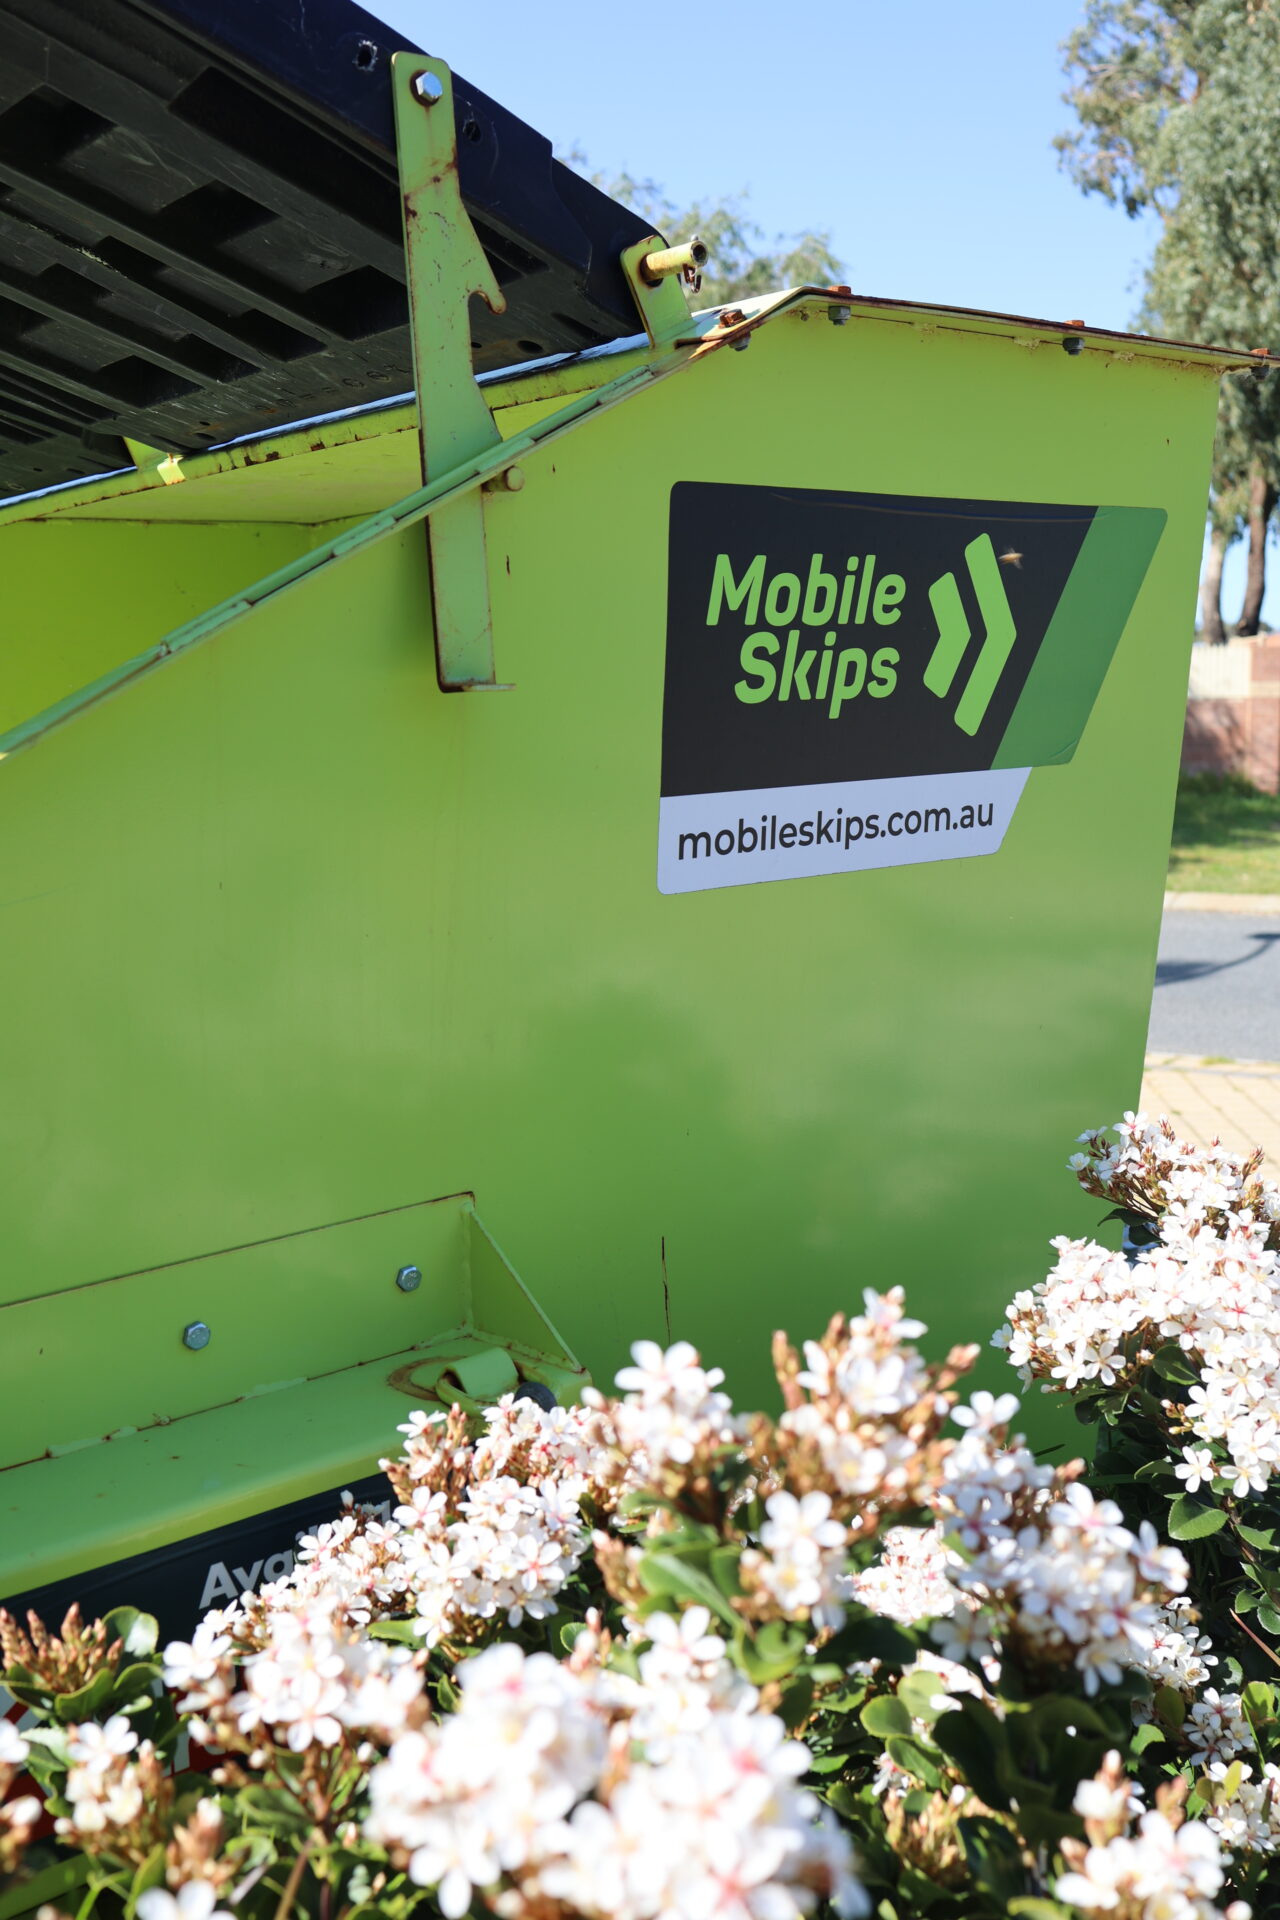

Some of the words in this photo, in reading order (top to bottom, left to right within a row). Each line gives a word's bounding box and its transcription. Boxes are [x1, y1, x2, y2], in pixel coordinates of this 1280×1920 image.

[705, 553, 907, 627] Mobile
[734, 629, 900, 720] Skips
[678, 802, 995, 861] mobileskips.com.au
